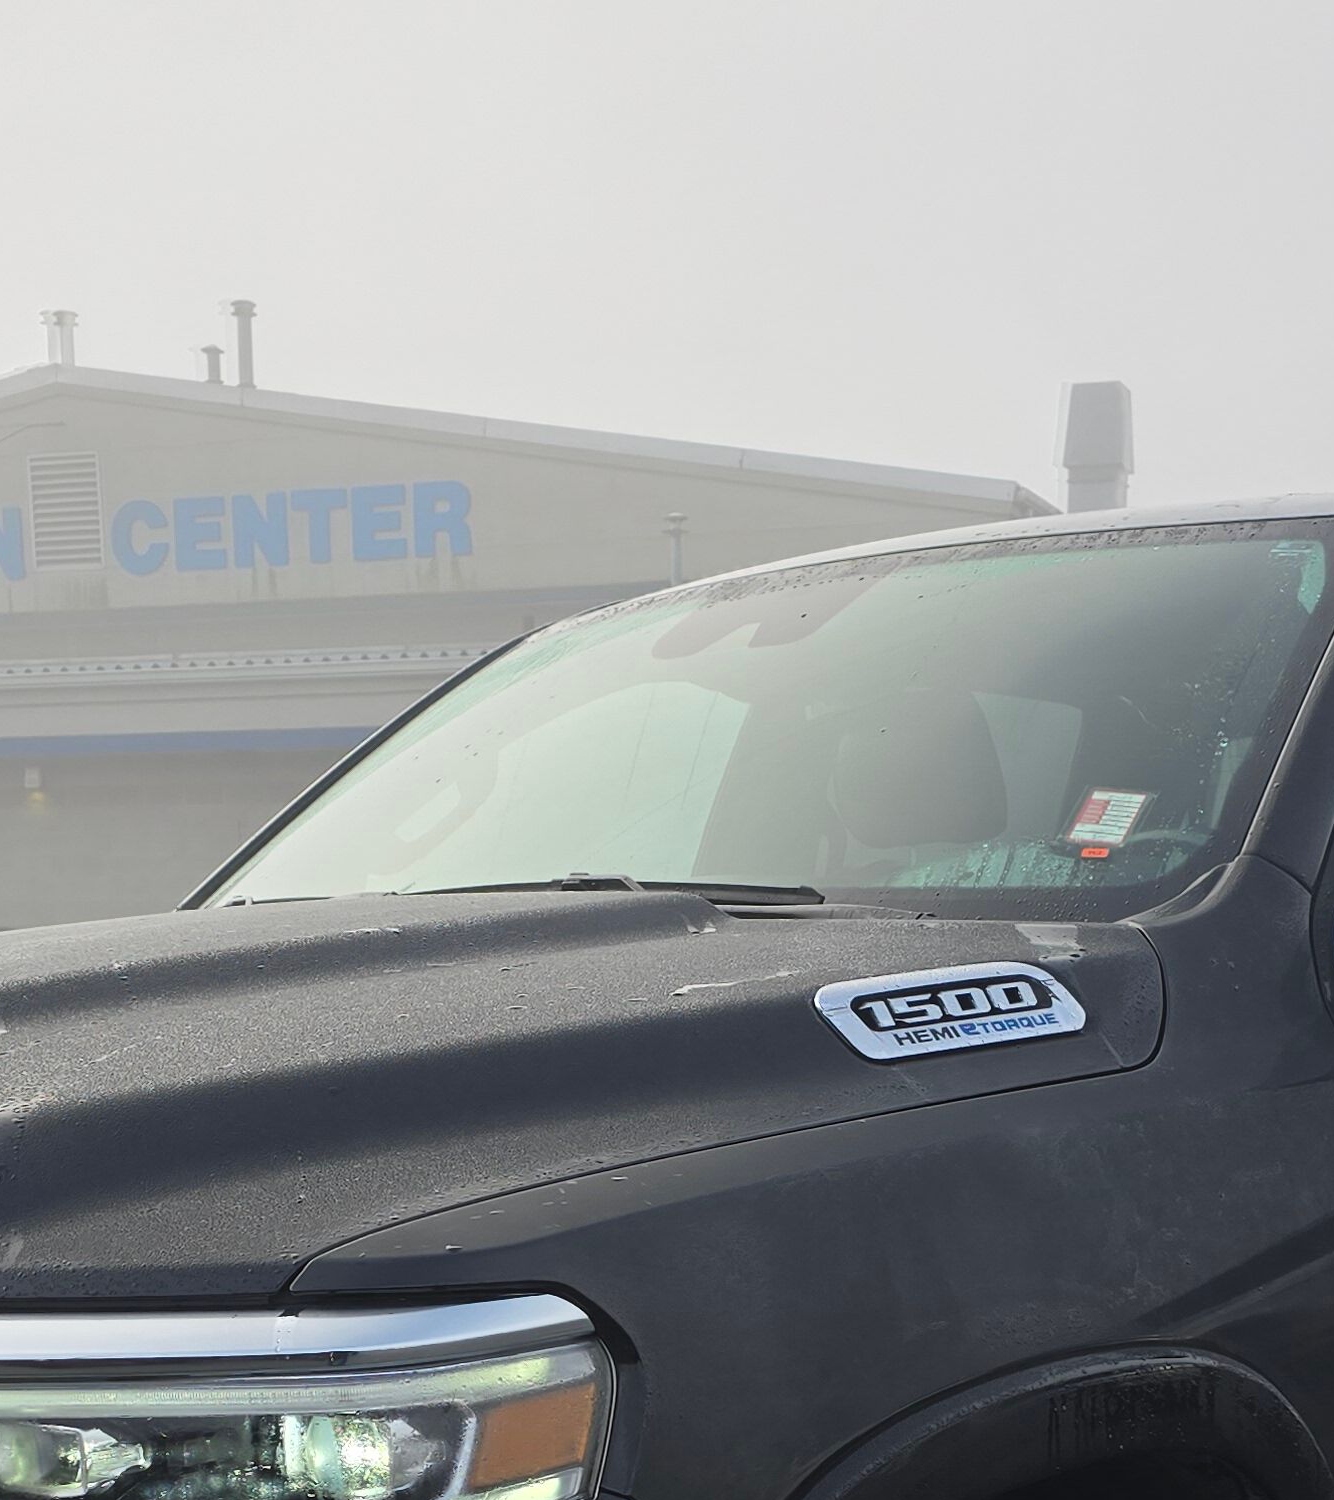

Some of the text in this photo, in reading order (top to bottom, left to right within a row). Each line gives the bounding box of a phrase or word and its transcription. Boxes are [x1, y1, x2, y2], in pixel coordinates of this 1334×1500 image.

[111, 481, 472, 576] CENTER
[859, 981, 1038, 1028] 1500
[893, 1026, 961, 1047] HEMI
